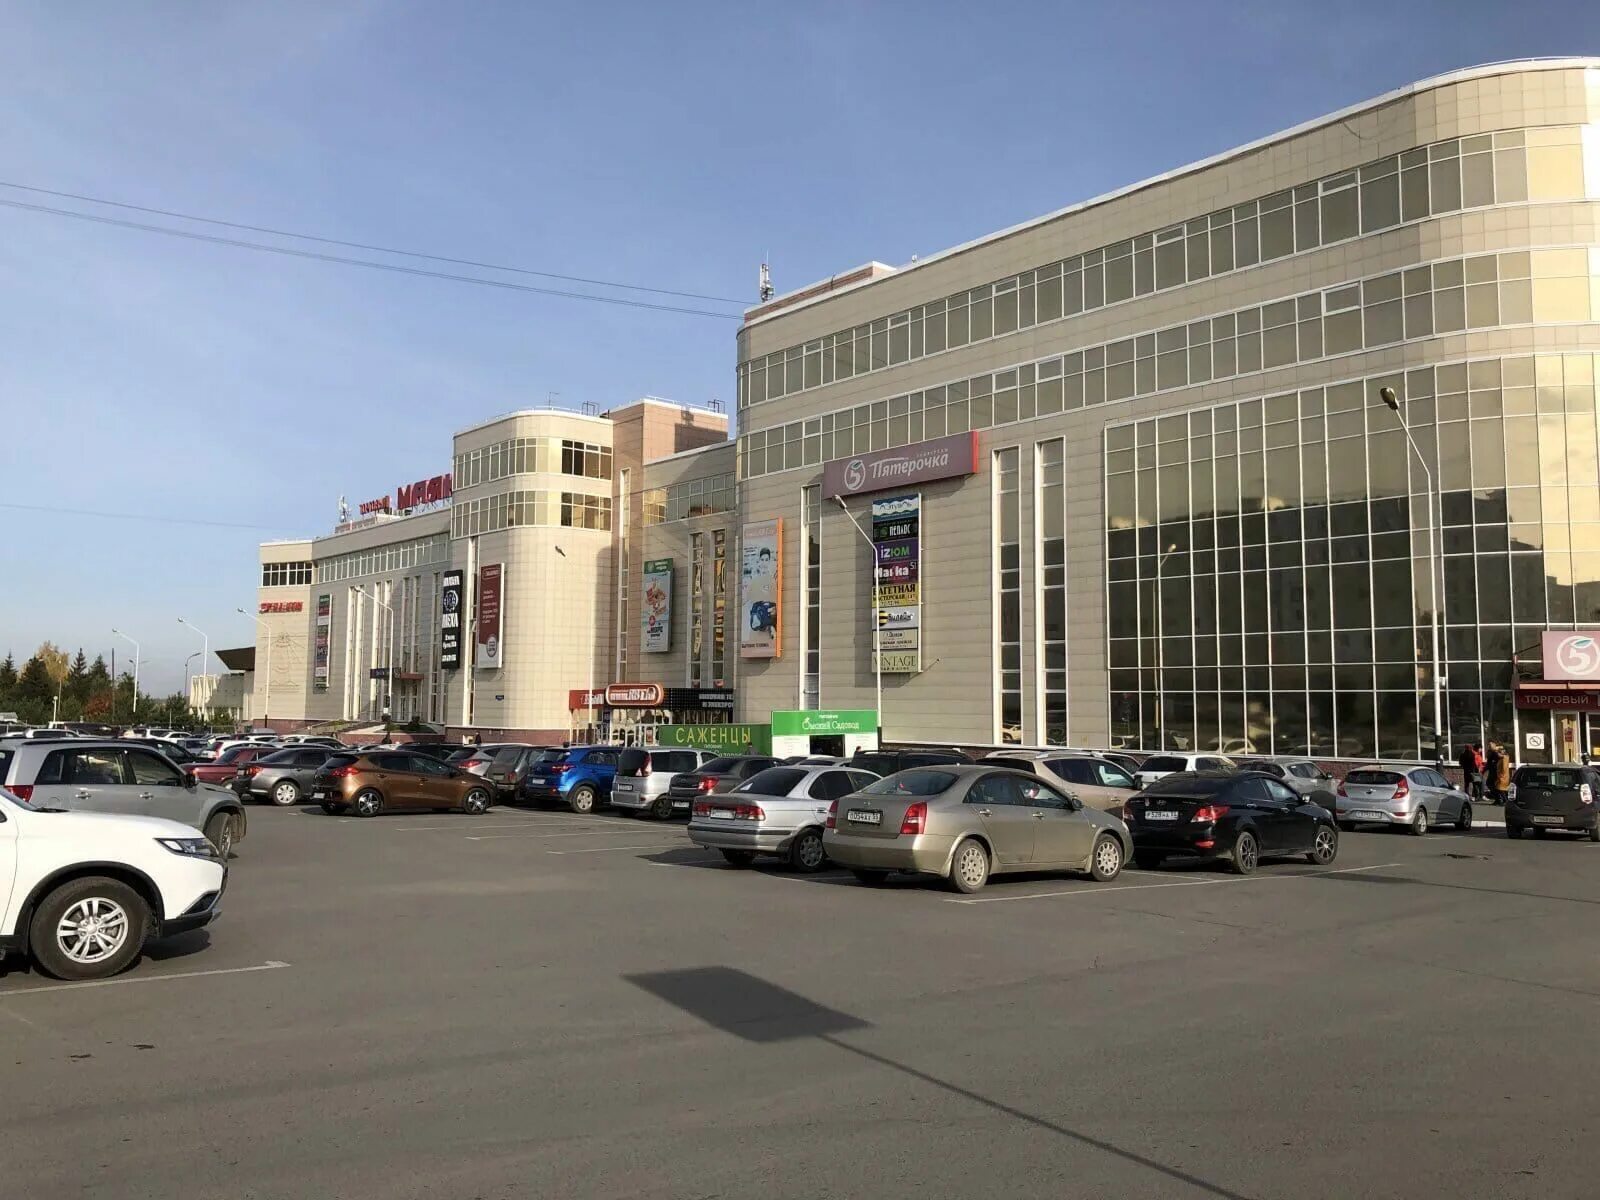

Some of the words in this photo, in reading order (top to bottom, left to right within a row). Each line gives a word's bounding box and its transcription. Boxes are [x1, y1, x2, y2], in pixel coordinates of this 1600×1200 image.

[869, 453, 949, 479] Пятерочка
[1525, 694, 1589, 704] ТОРГОВЫЙ
[832, 721, 859, 730] Садовод
[676, 727, 751, 746] САЖЕНЦЫ
